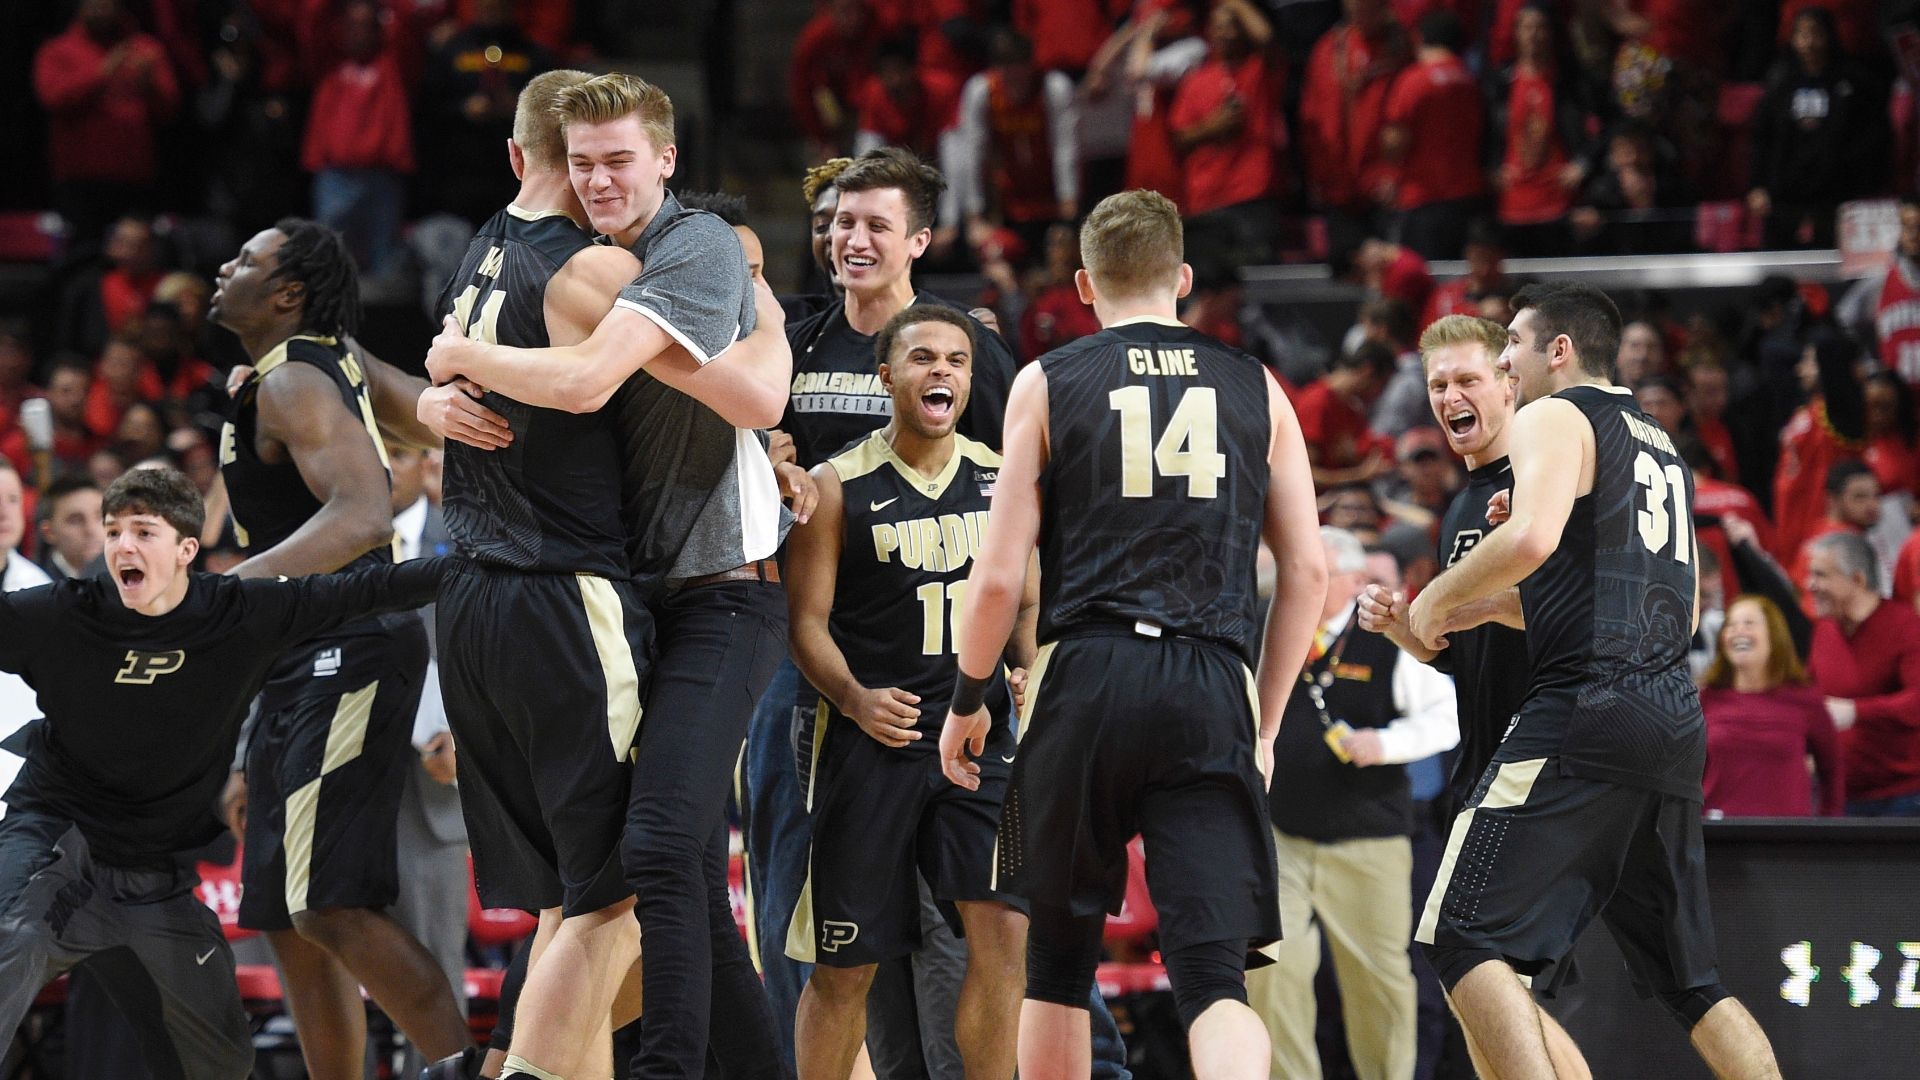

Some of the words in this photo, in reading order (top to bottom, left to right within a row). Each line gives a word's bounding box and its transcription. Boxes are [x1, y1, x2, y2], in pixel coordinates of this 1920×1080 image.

[1127, 348, 1199, 376] CLINE
[1108, 385, 1226, 499] 14
[1634, 450, 1689, 566] 31
[114, 649, 186, 685] P
[822, 920, 859, 953] P
